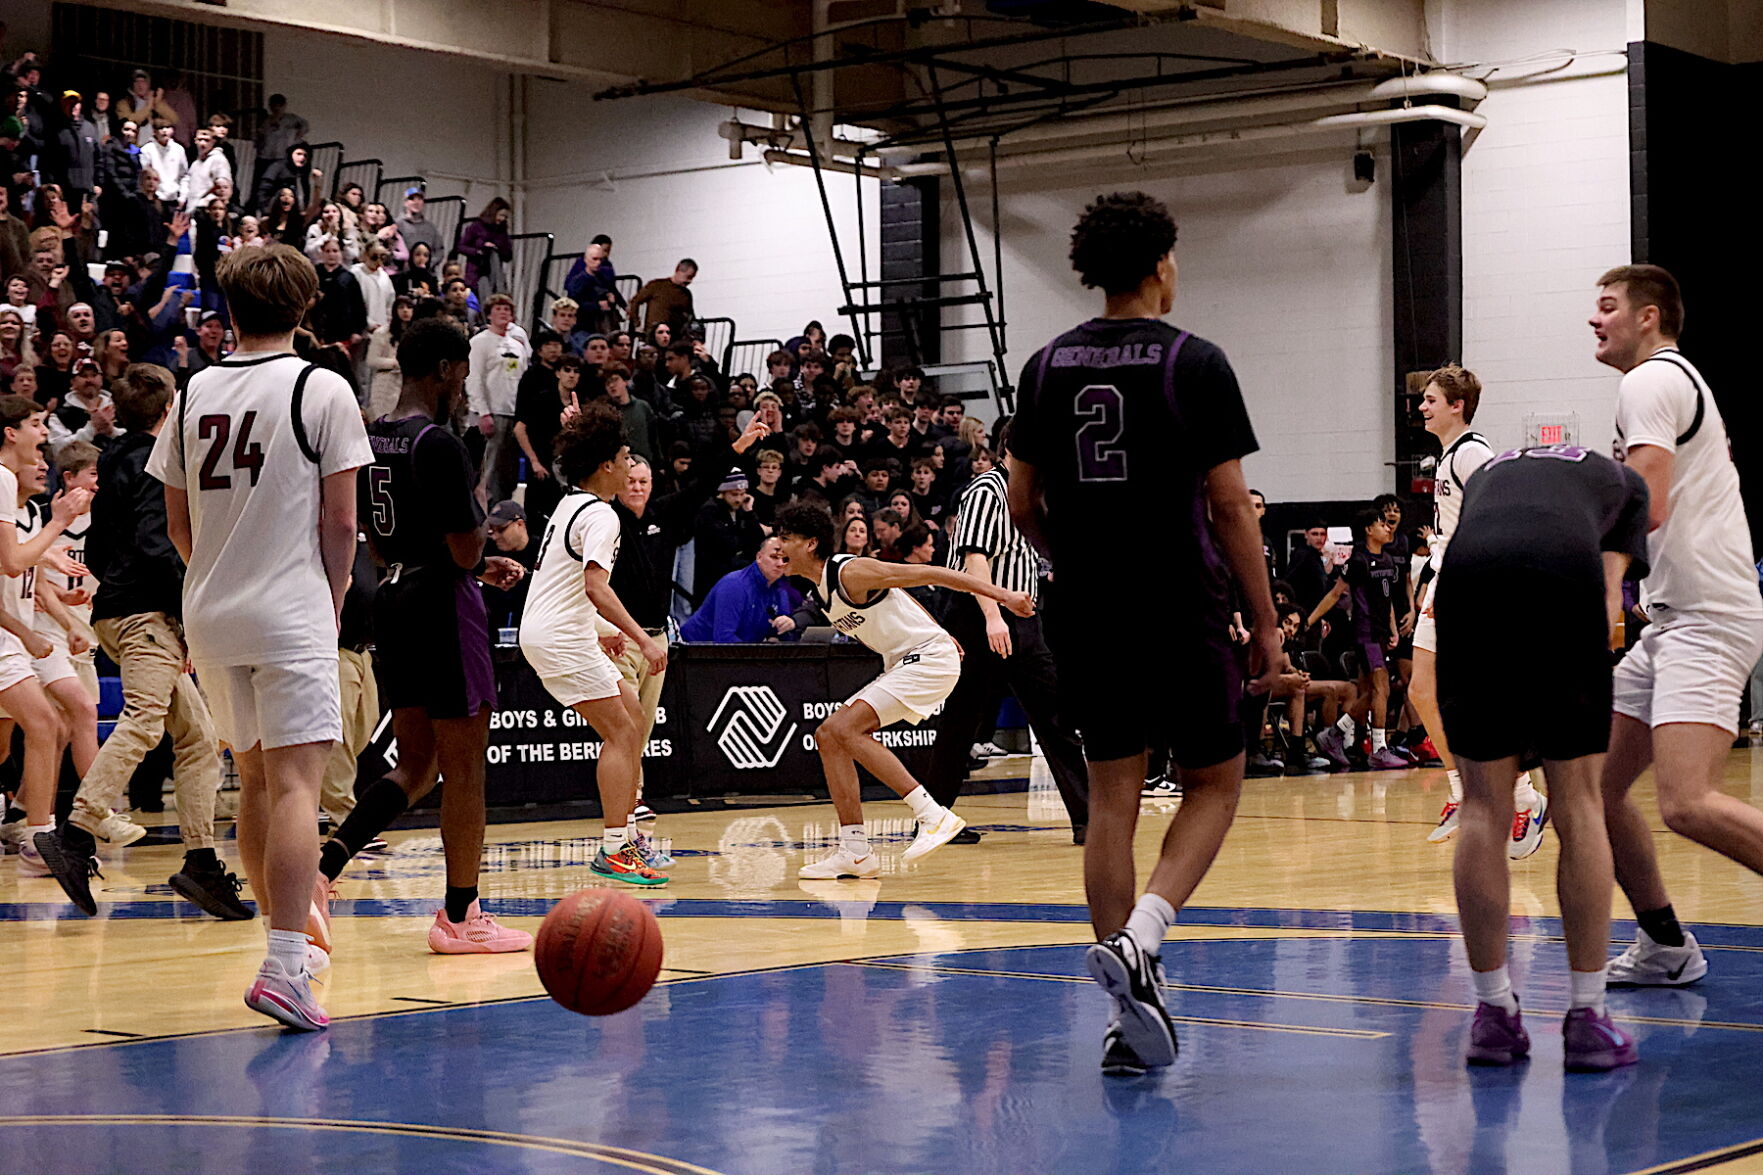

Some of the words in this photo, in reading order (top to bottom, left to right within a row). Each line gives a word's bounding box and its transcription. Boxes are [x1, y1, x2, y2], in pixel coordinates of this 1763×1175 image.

[198, 410, 265, 491] 24
[1074, 384, 1128, 482] 2
[368, 466, 396, 537] 5
[486, 745, 512, 764] OF
[516, 743, 555, 763] THE
[489, 710, 538, 730] BOYS
[543, 709, 557, 728] &
